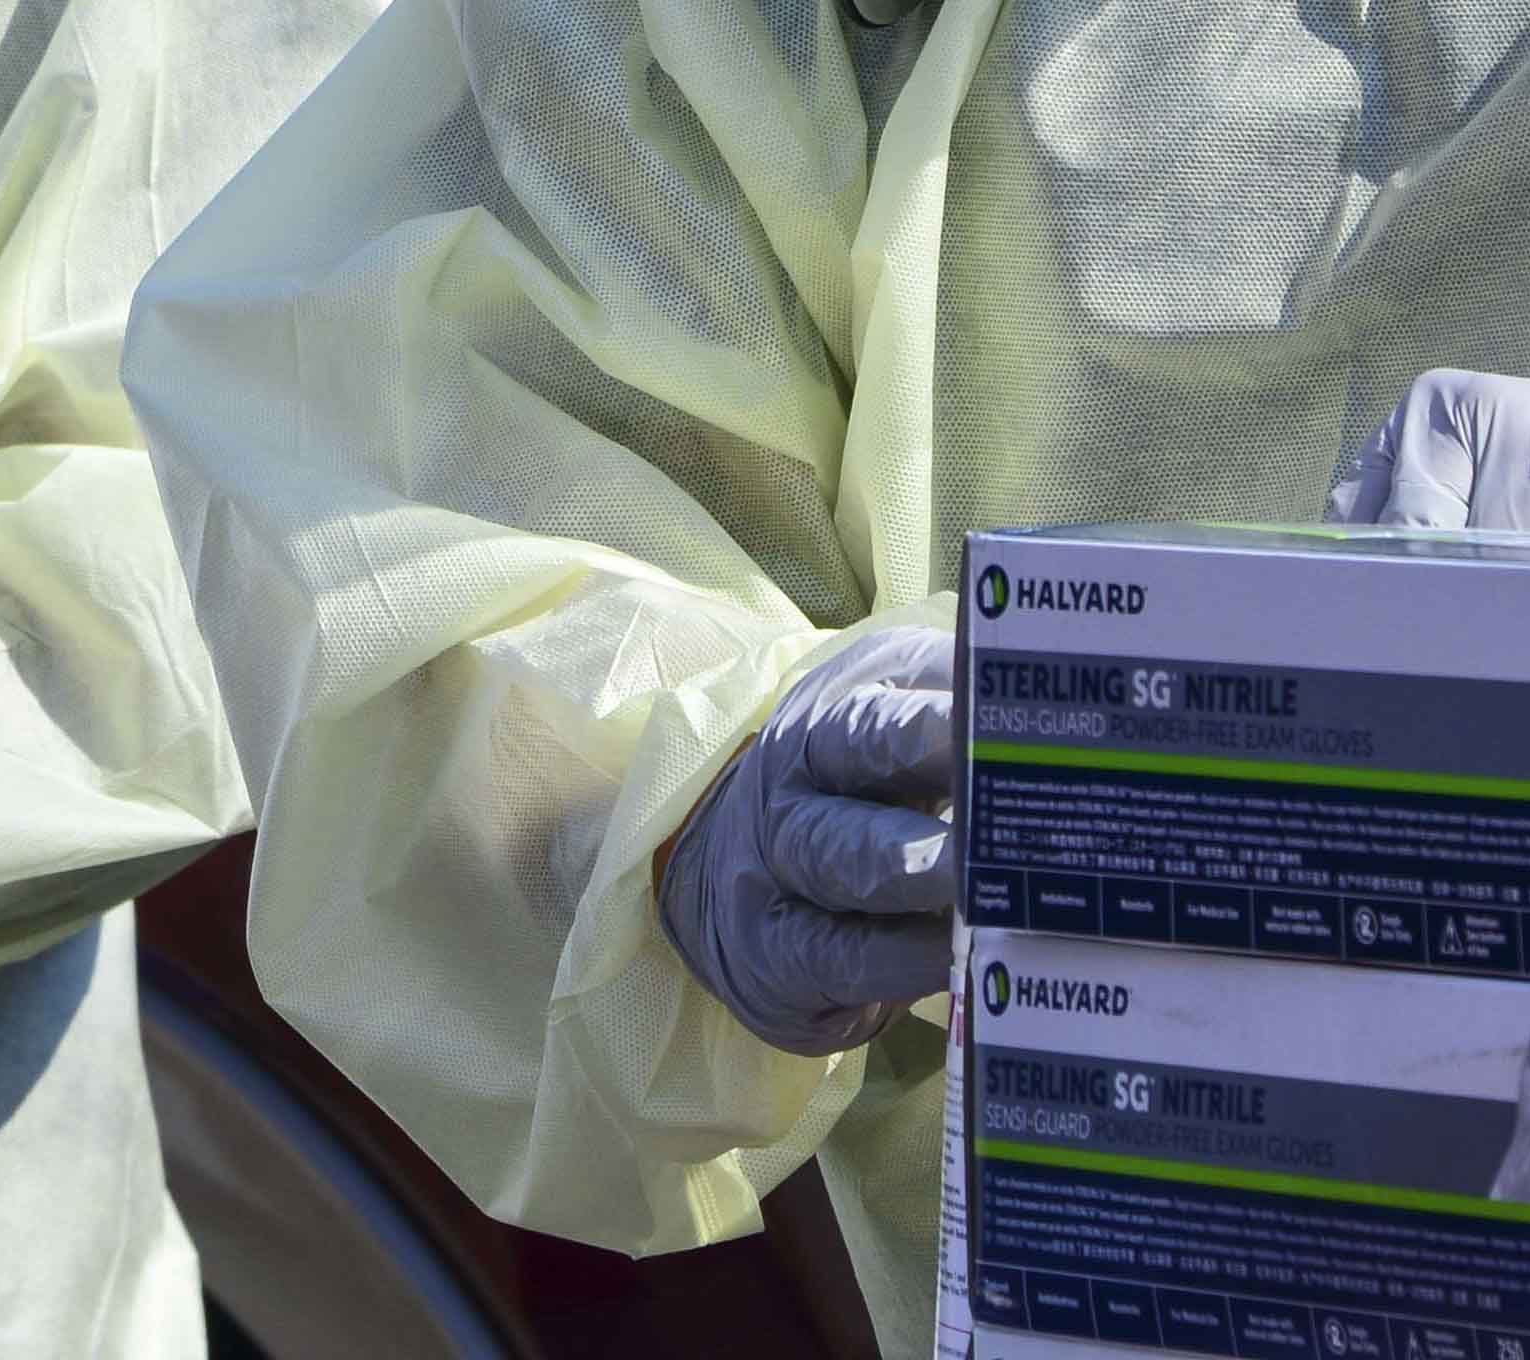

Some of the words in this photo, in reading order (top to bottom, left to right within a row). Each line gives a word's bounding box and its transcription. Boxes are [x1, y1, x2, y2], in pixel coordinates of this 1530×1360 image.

[1017, 578, 1146, 616] HALYARD
[979, 659, 1126, 706] STERLING
[1185, 673, 1299, 717] NITRILE
[978, 705, 1107, 738] SENSI-GUARD
[1110, 714, 1238, 749] POWDER-FREE
[1244, 724, 1295, 751] EXAM
[1299, 729, 1374, 757] GLOVES
[1016, 975, 1131, 1017] HALYARD
[986, 1058, 1109, 1107] STERLING
[1162, 1075, 1266, 1125] NITRILE
[985, 1104, 1091, 1140] SENSI-GUARD
[1266, 1136, 1335, 1168] GLOVES
